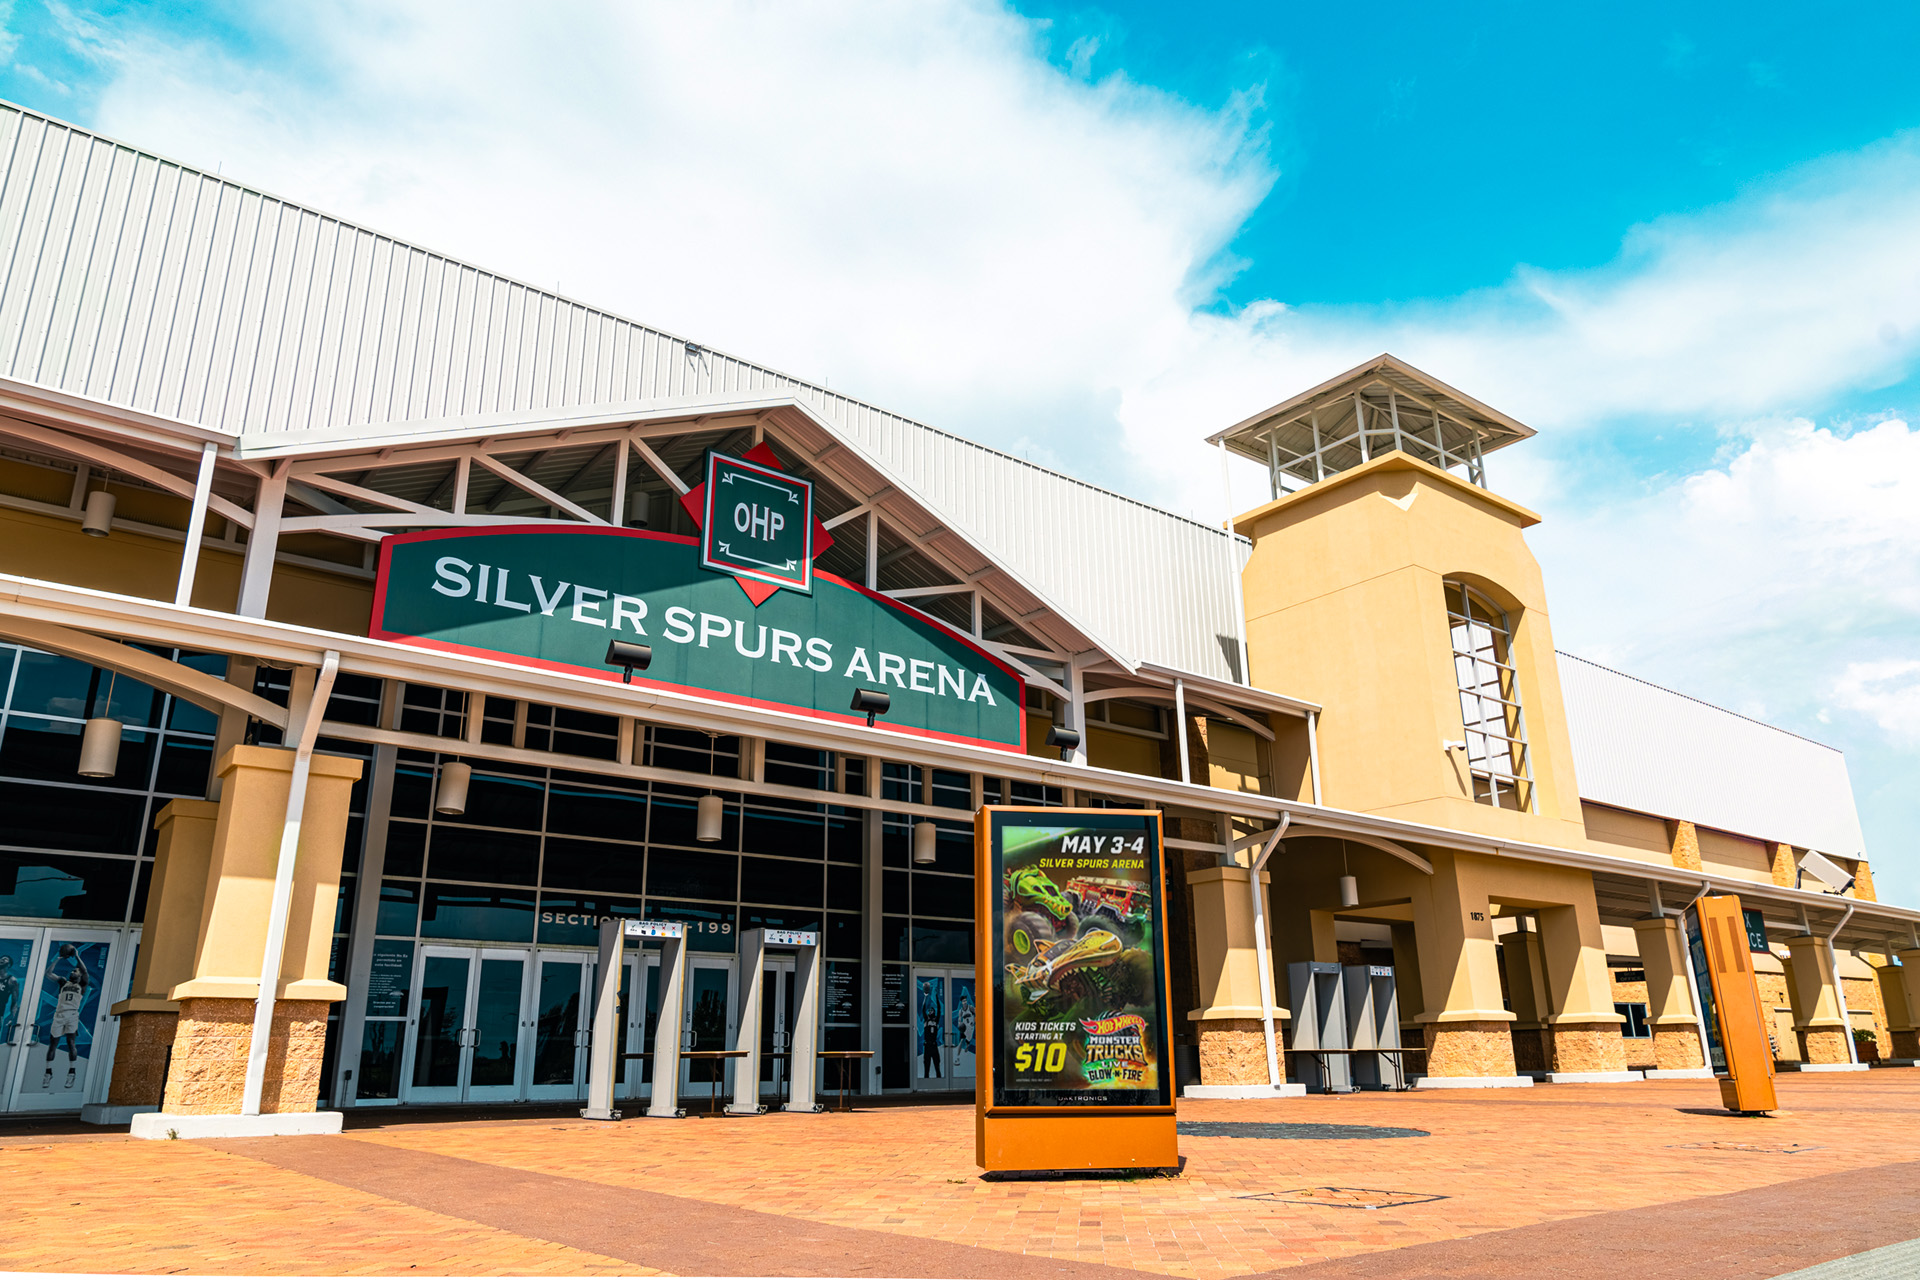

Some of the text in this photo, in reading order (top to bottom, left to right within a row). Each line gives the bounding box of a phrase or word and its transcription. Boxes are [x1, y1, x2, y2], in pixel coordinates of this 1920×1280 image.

[734, 502, 785, 541] OHP
[431, 556, 997, 706] SILVER SPURS ARENA
[1061, 836, 1144, 854] MAY 3-4
[1040, 858, 1144, 869] SILVER SPURS ARENA
[542, 911, 637, 926] SECTIO
[1470, 912, 1484, 921] 1875
[65, 993, 73, 1001] 13
[1015, 1022, 1076, 1031] KIDS TICKETS
[1096, 1015, 1142, 1034] HOT WHEELS
[1015, 1032, 1052, 1040] STARTING
[1089, 1036, 1140, 1044] MONSTER
[1014, 1042, 1067, 1072] $10
[1085, 1045, 1147, 1065] TRUCKS
